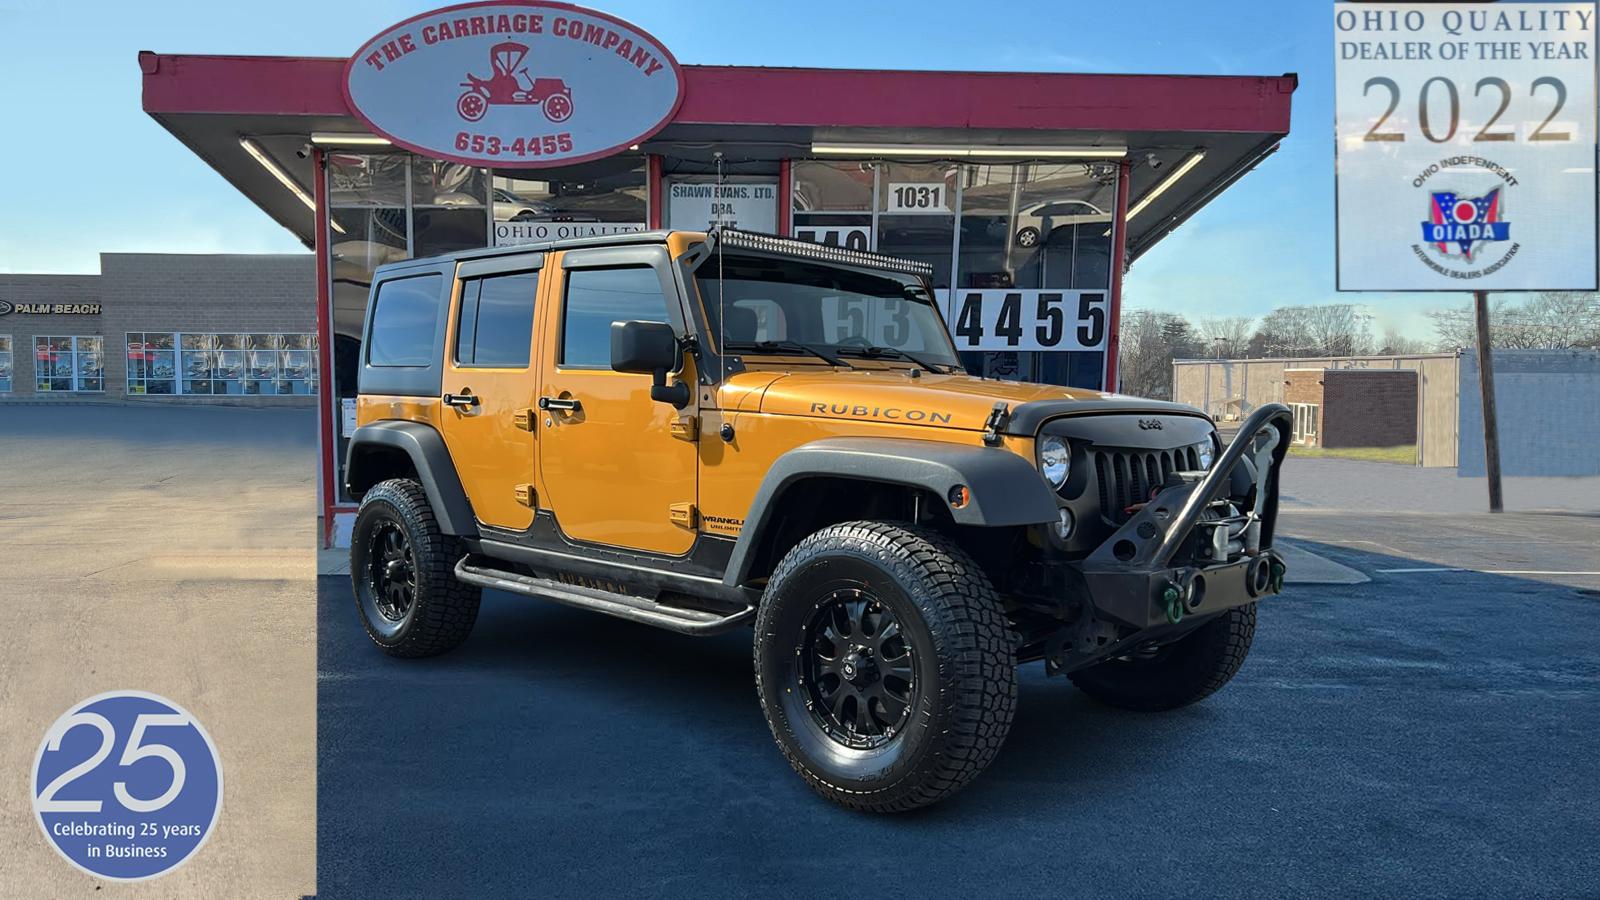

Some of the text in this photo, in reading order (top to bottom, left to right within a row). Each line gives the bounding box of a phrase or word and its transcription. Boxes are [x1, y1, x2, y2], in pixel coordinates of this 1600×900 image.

[1336, 10, 1592, 35] OHIO QUALITY
[365, 14, 664, 78] THE CARRIAGE COMPANY
[1340, 42, 1589, 60] DEALER OF THE YEAR
[1362, 76, 1571, 143] 2022
[454, 132, 573, 156] 653-4455
[1412, 156, 1519, 188] OHIO INDEPENDENT
[672, 186, 712, 198] SHAWN
[894, 187, 941, 209] 1031
[497, 226, 548, 239] OHIO
[1432, 225, 1495, 240] OIADA
[15, 303, 100, 314] PALM BEACH
[956, 293, 1105, 347] 4455
[810, 402, 952, 424] RUBICON
